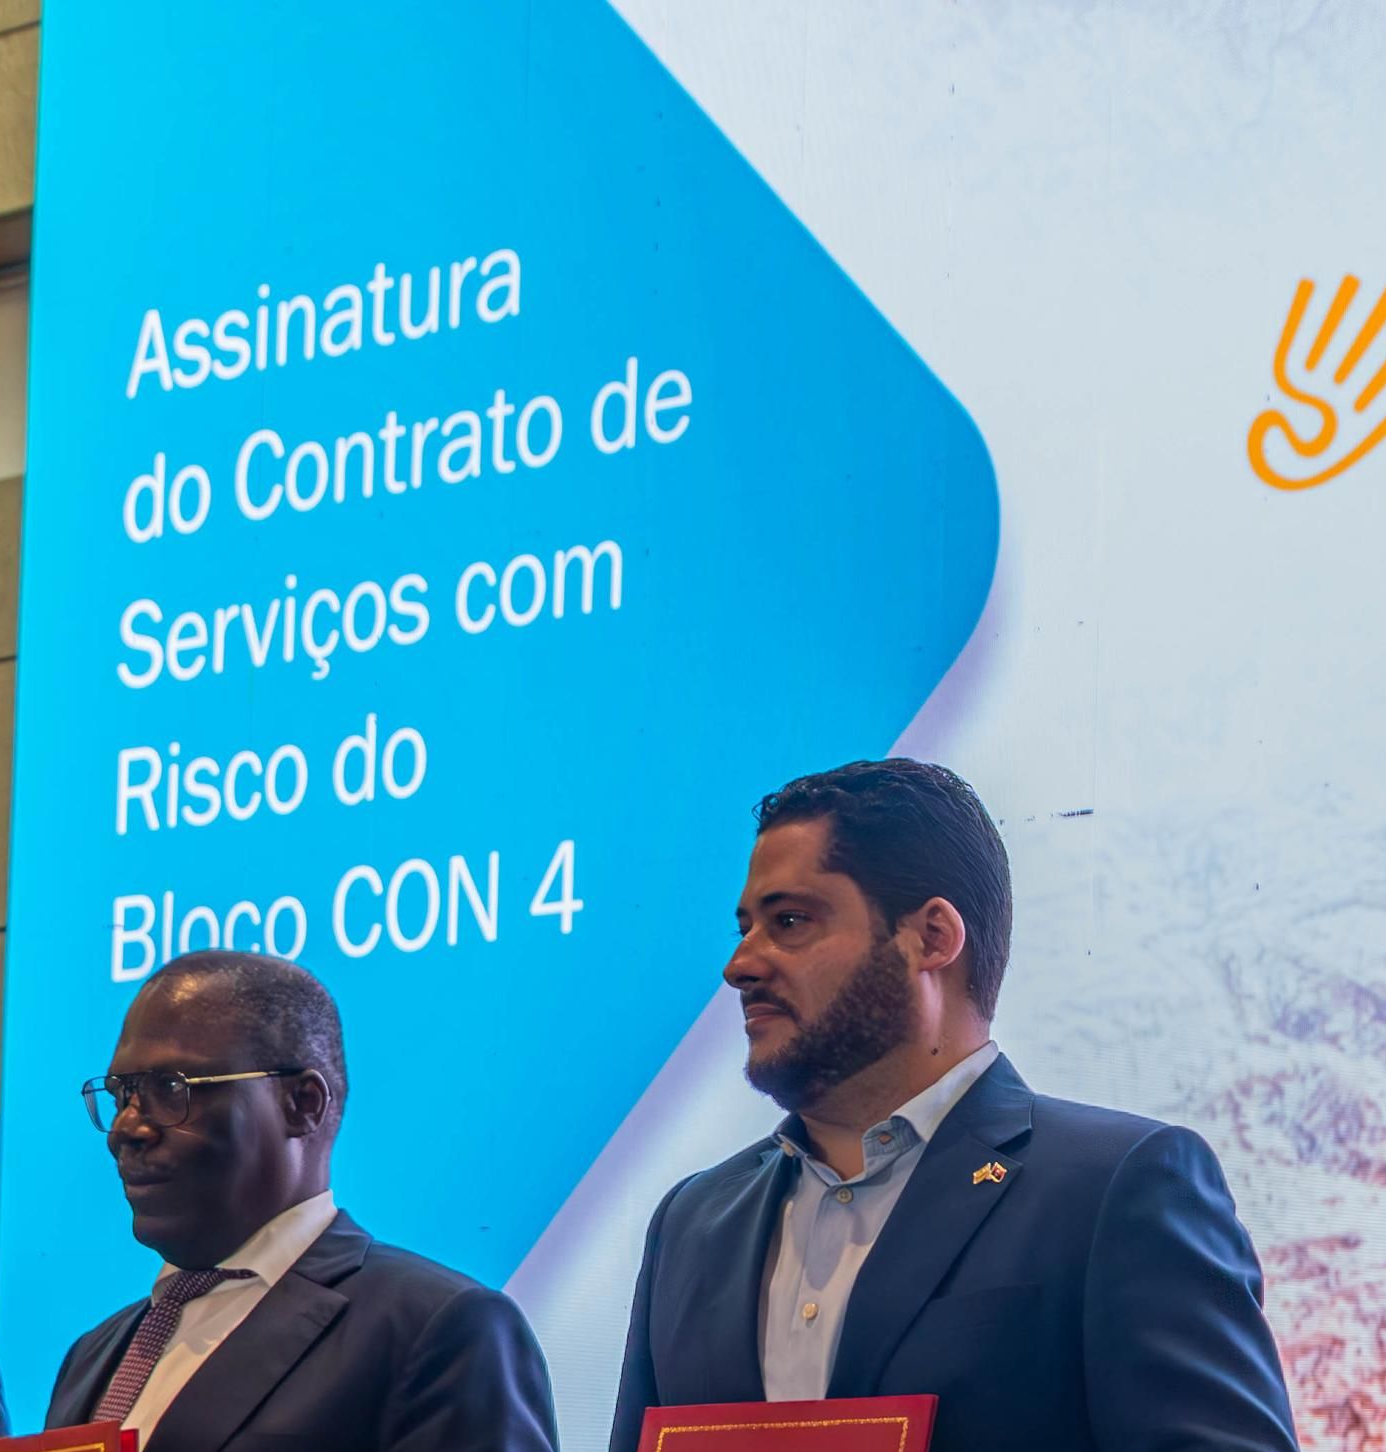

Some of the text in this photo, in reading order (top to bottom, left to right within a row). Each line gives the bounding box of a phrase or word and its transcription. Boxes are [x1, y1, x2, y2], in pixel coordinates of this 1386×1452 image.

[126, 248, 521, 399] Assinatura
[123, 357, 693, 543] do Contrato de
[117, 540, 623, 689] Serviços com
[116, 713, 428, 835] Risco do
[111, 840, 583, 983] Bloco CON 4
